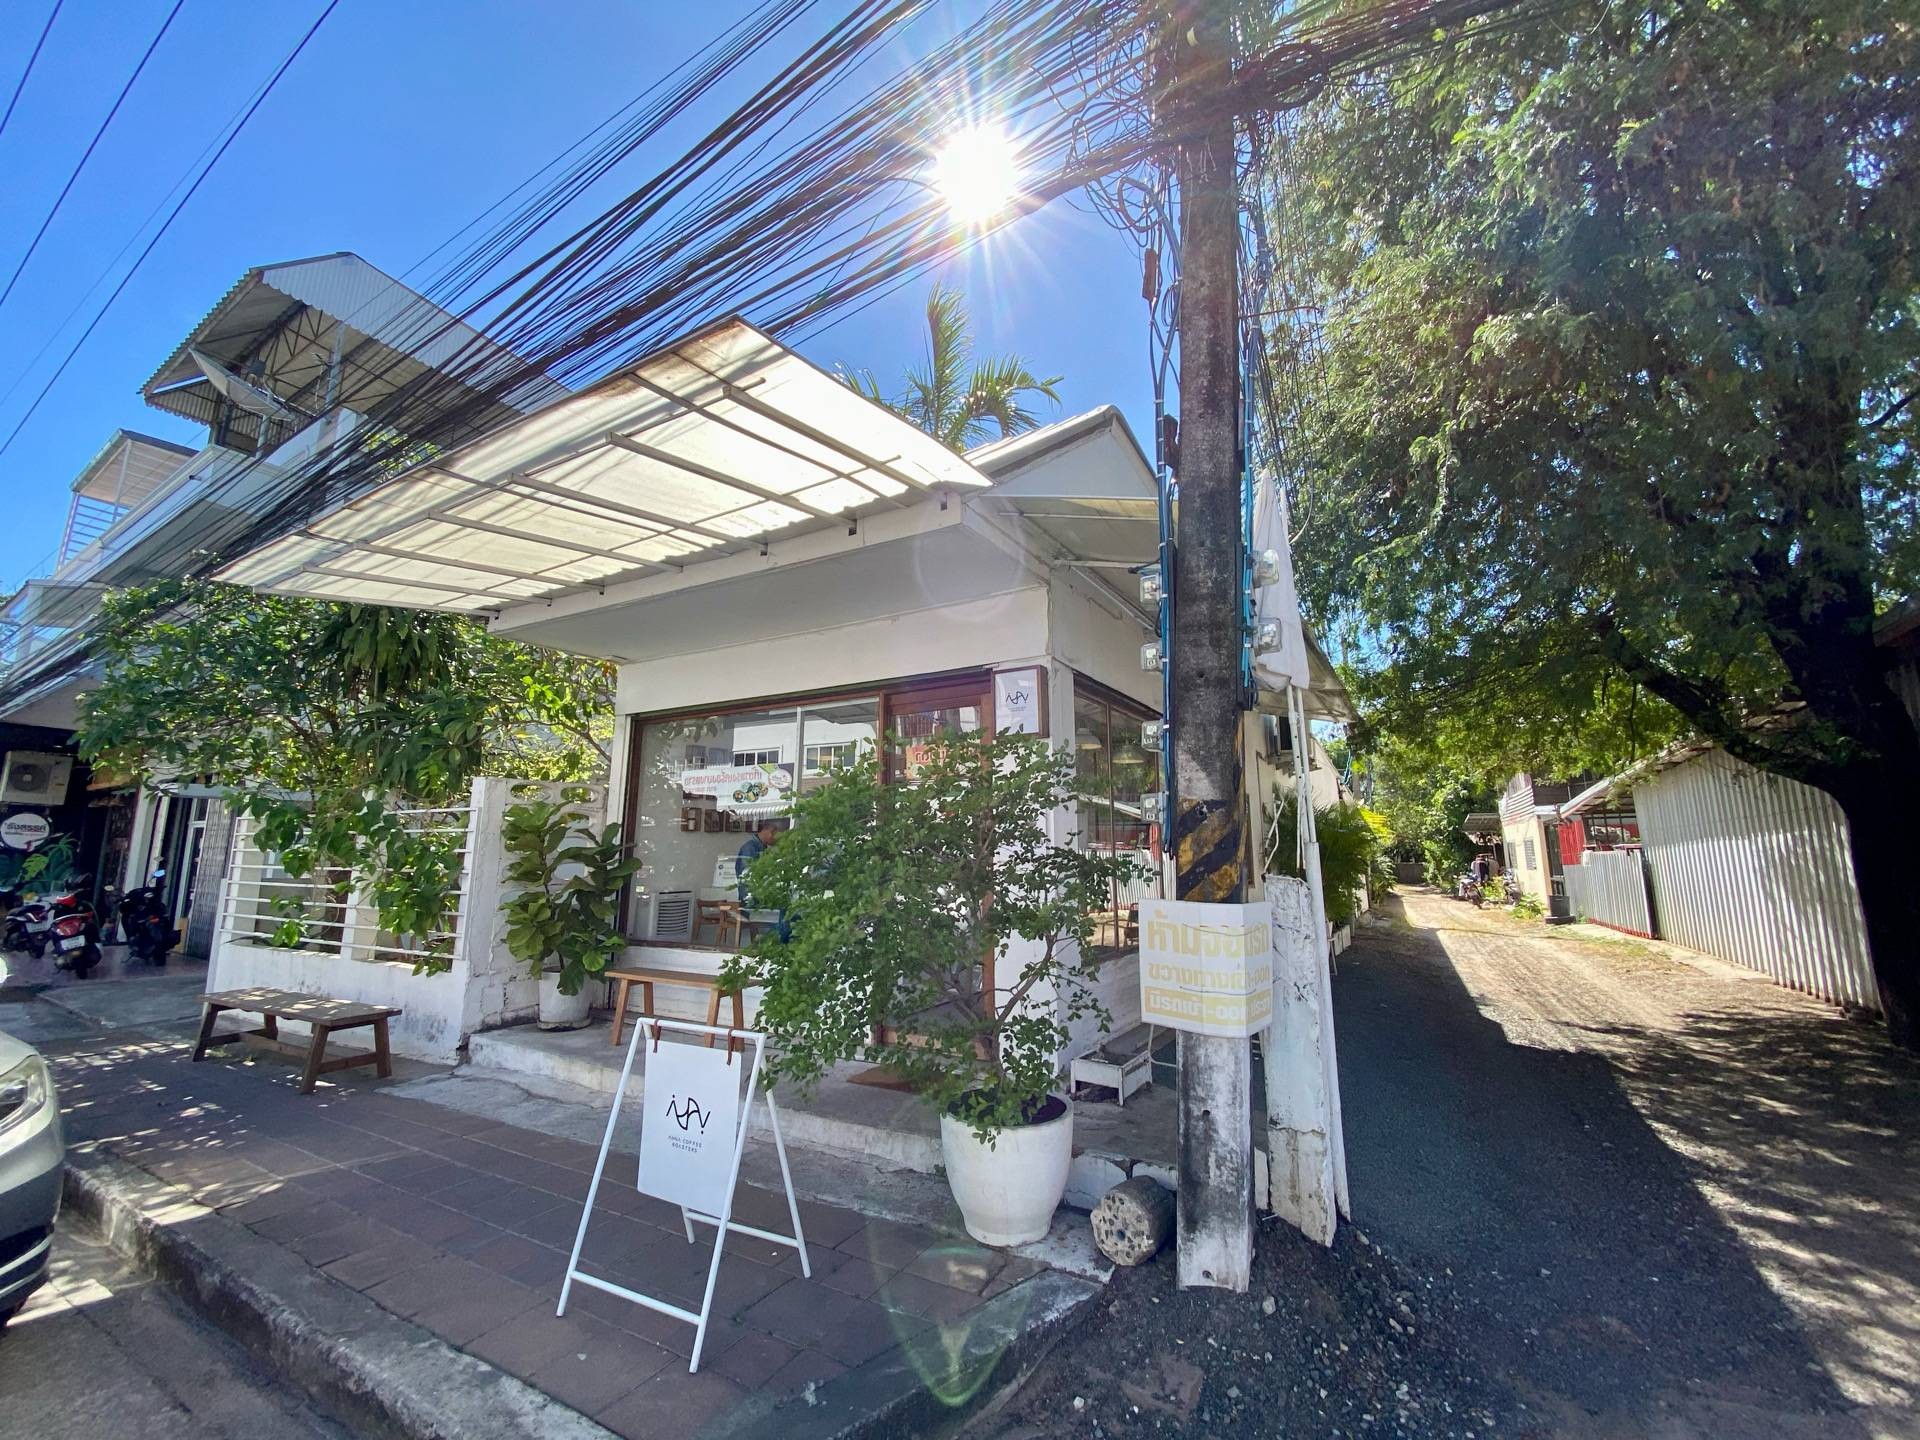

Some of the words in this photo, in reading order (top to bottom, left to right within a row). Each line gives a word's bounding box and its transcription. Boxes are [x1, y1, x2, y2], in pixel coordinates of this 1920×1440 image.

[1147, 908, 1269, 958] ห้ามจอดรถ
[672, 1142, 698, 1153] ROASTERS
[682, 1138, 702, 1149] COFFEE
